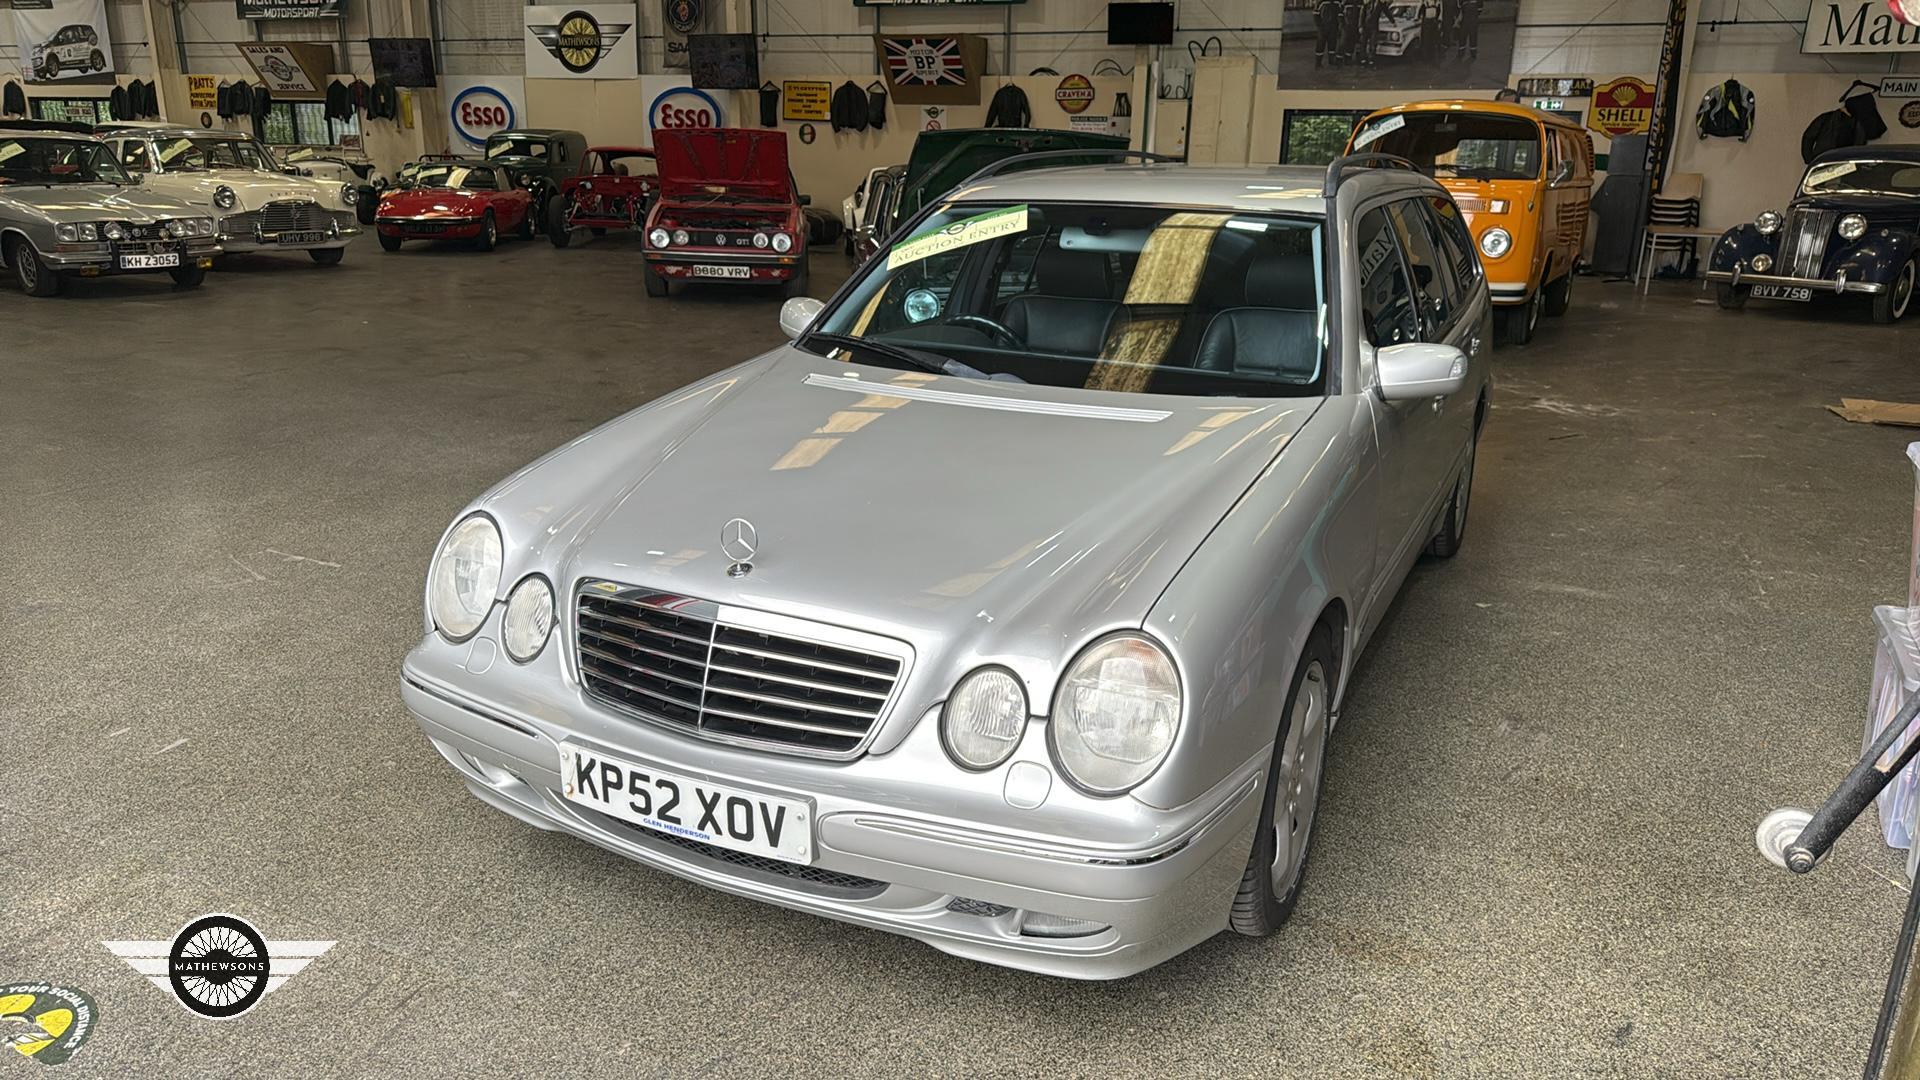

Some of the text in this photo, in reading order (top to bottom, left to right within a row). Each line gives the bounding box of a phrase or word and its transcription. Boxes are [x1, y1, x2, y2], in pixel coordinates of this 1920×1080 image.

[263, 7, 320, 18] MOTORSPORT
[1819, 1, 1920, 46] Mat
[913, 56, 935, 69] BP
[188, 76, 214, 90] PRATTS
[1883, 82, 1918, 92] MAIN
[1057, 90, 1086, 98] CRAVEN
[1597, 108, 1645, 122] SHELL
[736, 238, 750, 246] GTI
[894, 236, 963, 264] AUCTION
[969, 219, 1020, 240] ENTRY
[127, 255, 178, 267] KH Z3052
[727, 267, 749, 277] VRV
[1753, 285, 1809, 299] BVV 758
[575, 752, 786, 848] KP52 XOV
[643, 817, 662, 828] GLEN
[663, 824, 711, 841] HENDERSON
[9, 985, 90, 1049] YOUR SOCIAL DISTANCE
